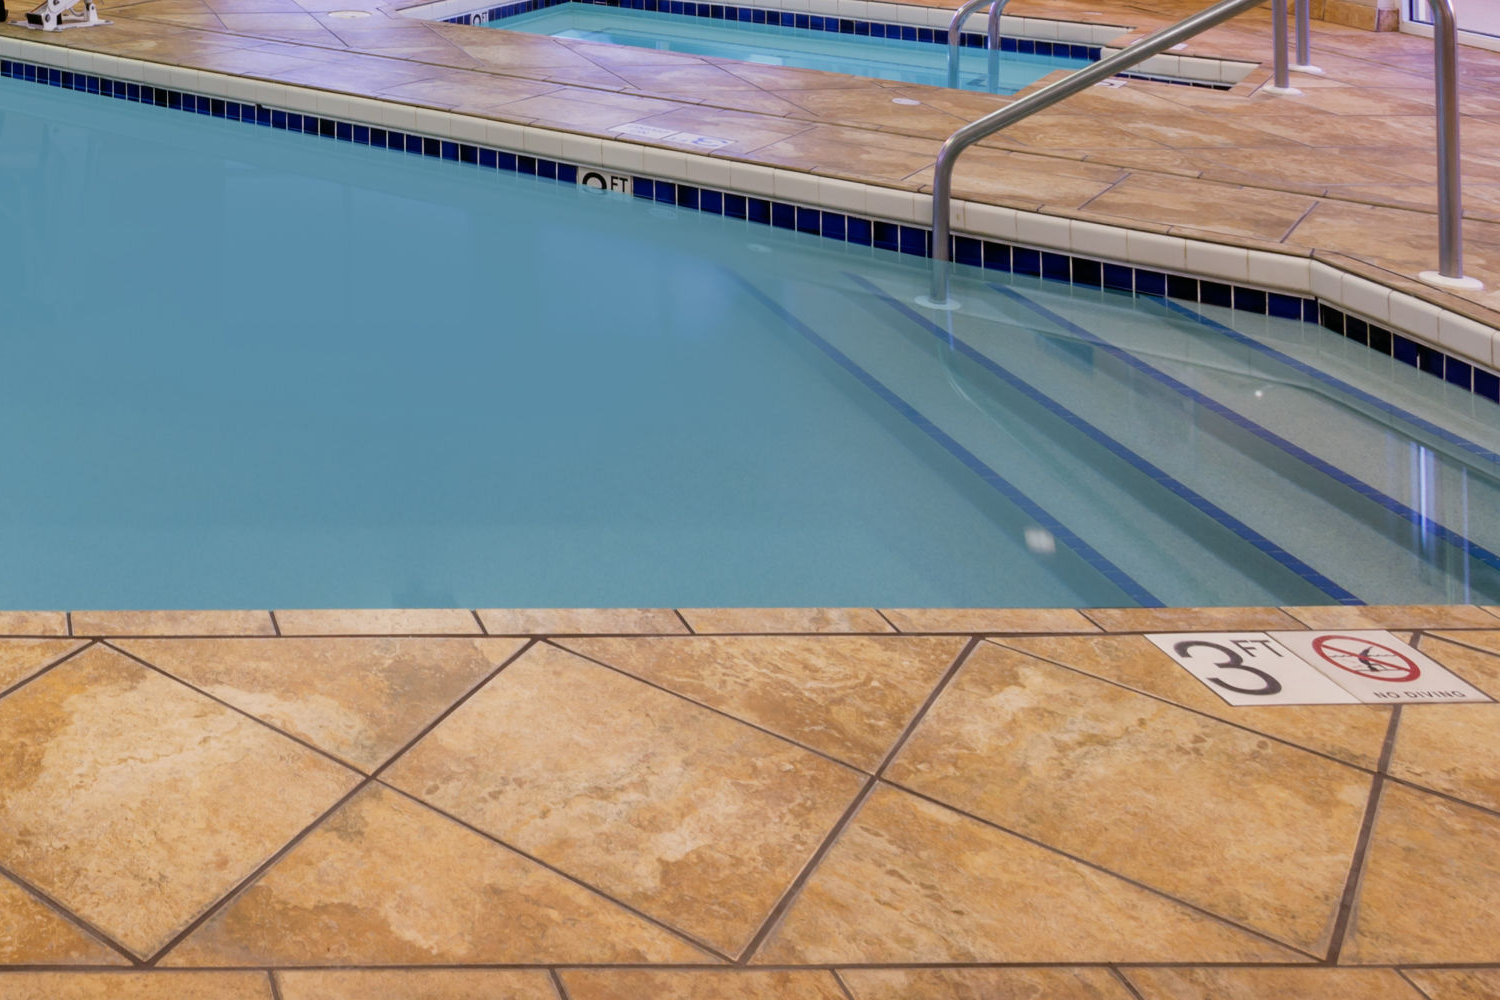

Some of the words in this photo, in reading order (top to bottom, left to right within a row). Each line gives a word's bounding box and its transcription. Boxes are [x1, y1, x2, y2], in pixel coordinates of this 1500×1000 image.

[610, 175, 629, 193] FT
[1172, 639, 1283, 697] 3
[1229, 639, 1285, 658] FT
[1373, 690, 1401, 700] NO
[1404, 689, 1467, 699] DIVING
